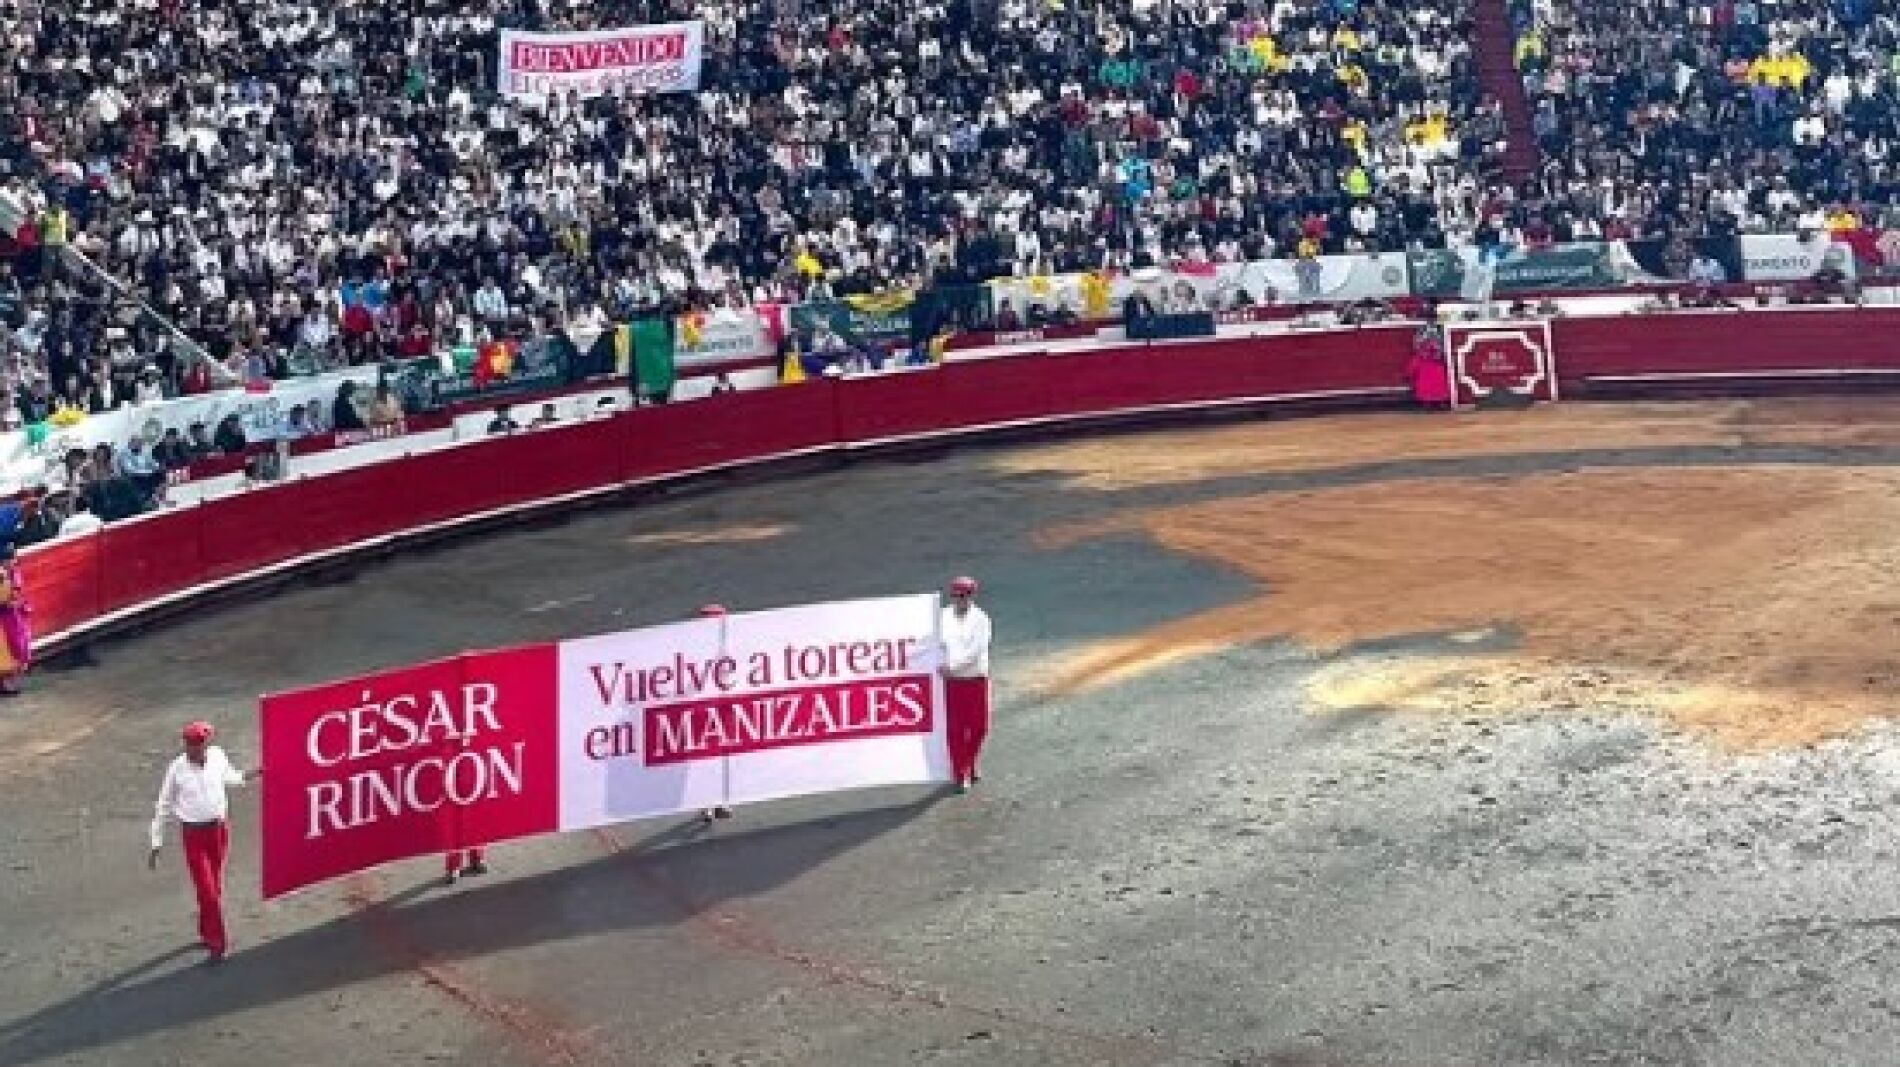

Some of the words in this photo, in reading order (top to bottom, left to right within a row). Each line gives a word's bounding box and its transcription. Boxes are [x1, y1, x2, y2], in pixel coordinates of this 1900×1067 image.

[516, 37, 680, 70] BIENVENIDO
[588, 653, 737, 705] Vuelve
[747, 652, 772, 687] a
[784, 637, 916, 680] torear
[307, 683, 503, 767] CÉSAR
[584, 721, 636, 760] en
[653, 683, 925, 757] MANIZALES
[304, 736, 526, 839] RINCÓN
